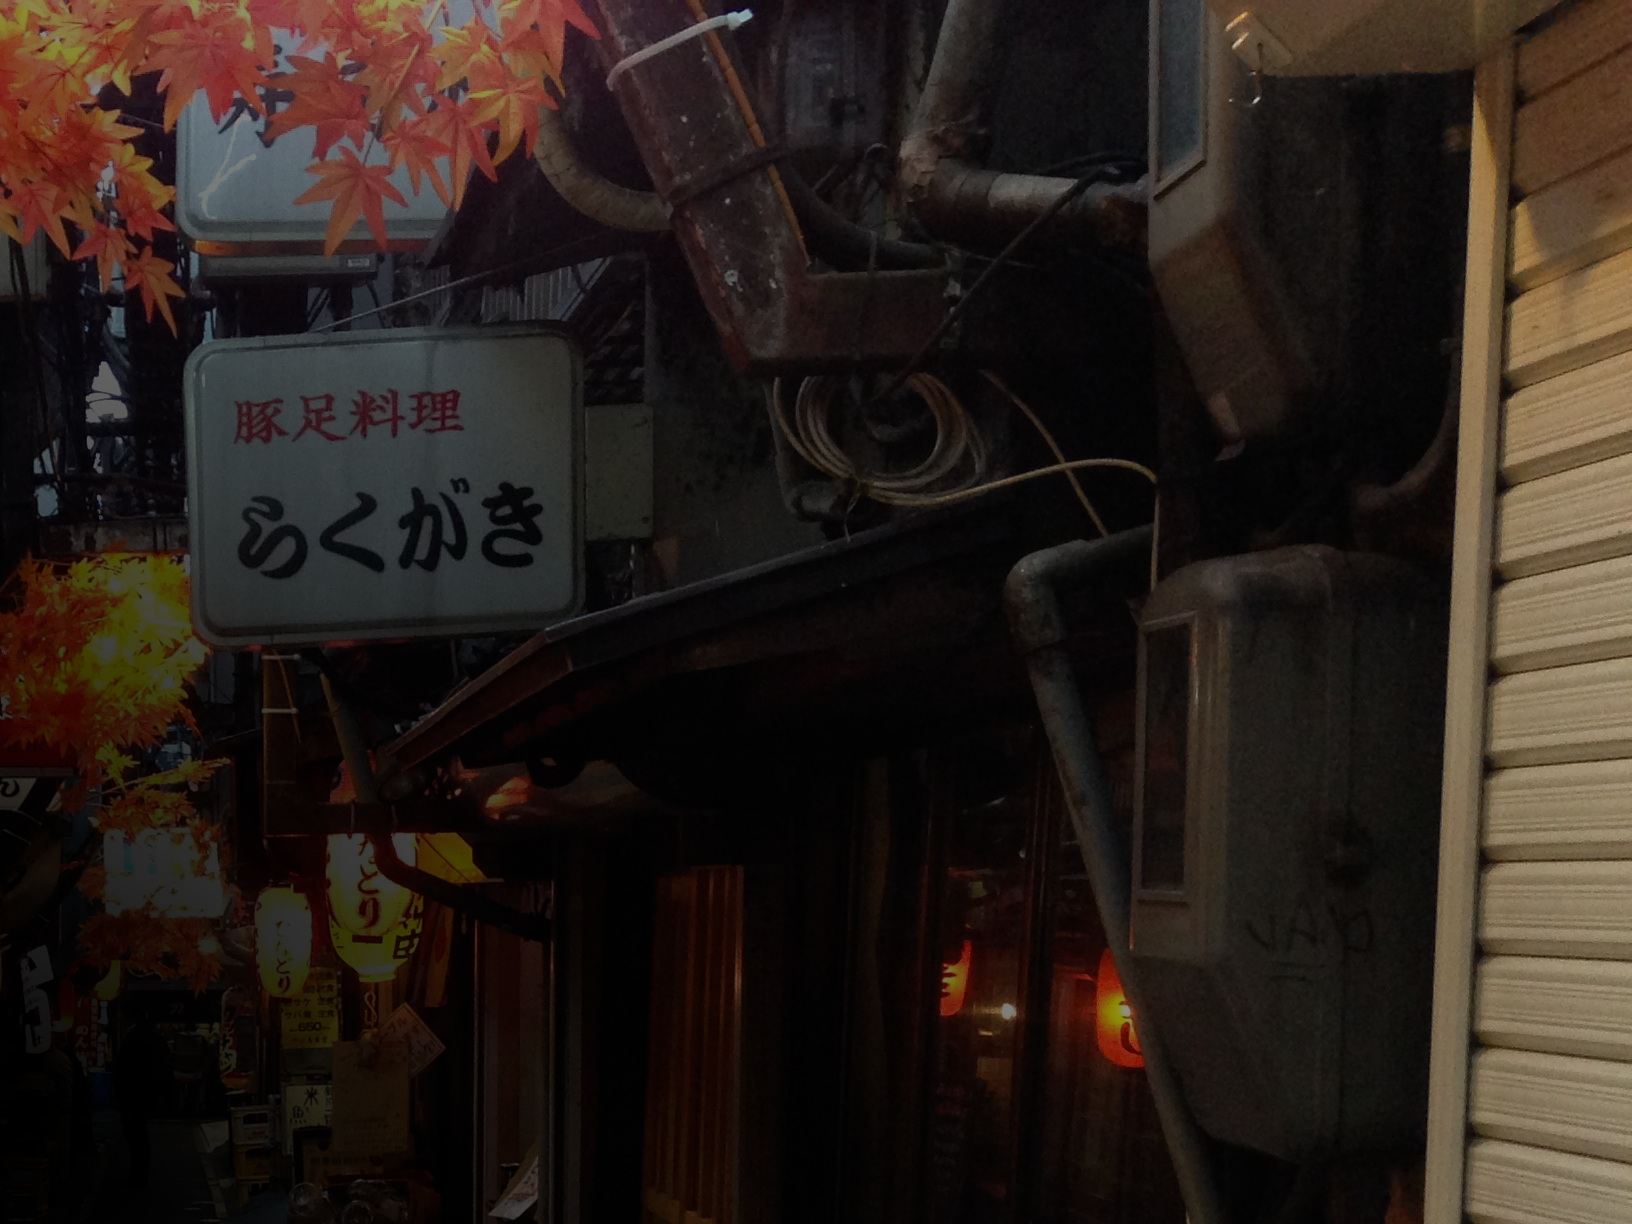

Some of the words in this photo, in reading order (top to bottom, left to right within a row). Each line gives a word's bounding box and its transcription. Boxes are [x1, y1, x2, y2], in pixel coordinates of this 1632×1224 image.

[234, 388, 464, 445] 豚足料理
[238, 477, 544, 579] らくがき
